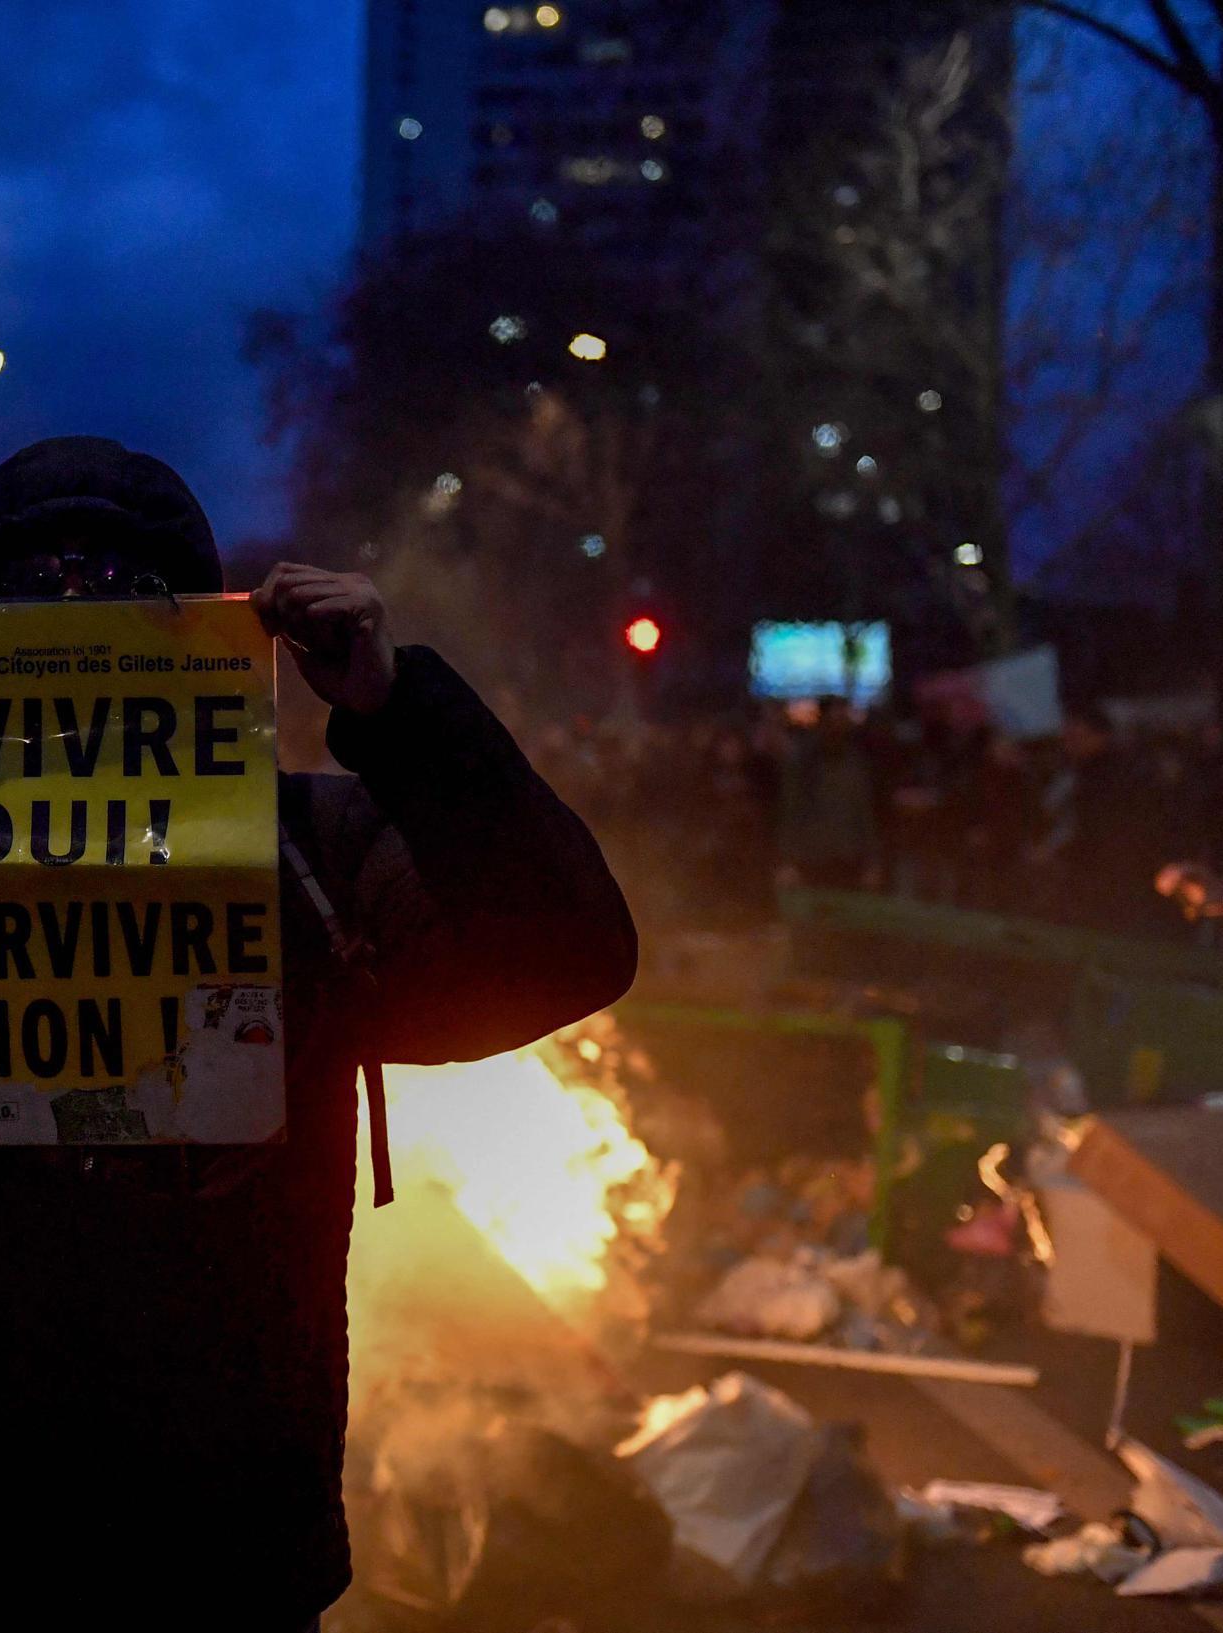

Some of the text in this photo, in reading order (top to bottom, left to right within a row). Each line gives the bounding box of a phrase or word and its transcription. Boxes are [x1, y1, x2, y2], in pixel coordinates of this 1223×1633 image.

[14, 646, 71, 656] Association
[88, 645, 112, 655] 1901
[77, 655, 111, 674] des
[118, 655, 174, 673] Gilets
[180, 655, 251, 672] Jaunes
